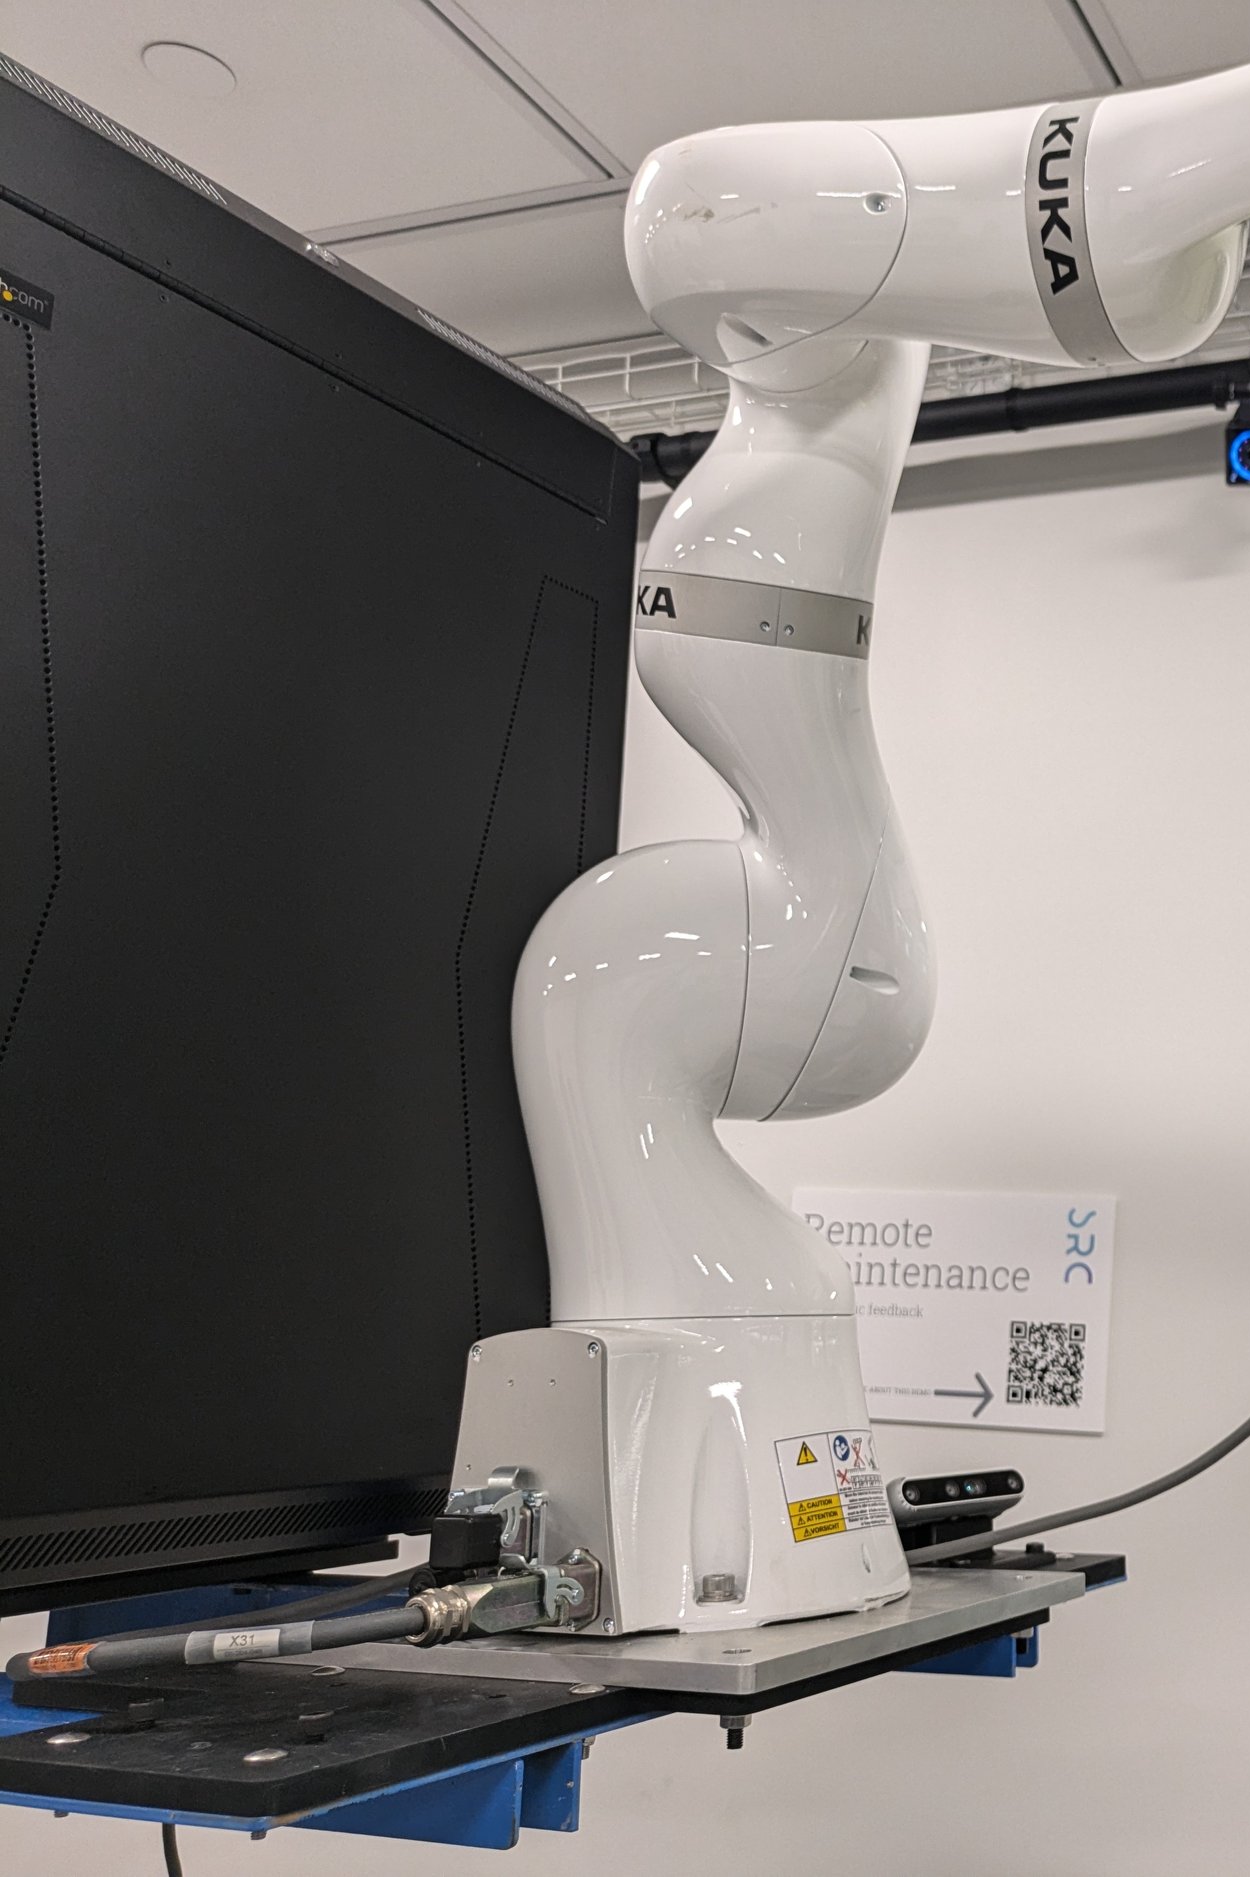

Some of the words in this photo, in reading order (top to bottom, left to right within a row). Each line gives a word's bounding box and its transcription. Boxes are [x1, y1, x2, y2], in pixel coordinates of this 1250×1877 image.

[1038, 116, 1080, 296] KUKA
[636, 585, 677, 619] KA
[1064, 1207, 1097, 1285] SRC
[846, 1252, 1031, 1293] intenance
[868, 1303, 924, 1319] feedback
[806, 1498, 833, 1509] CAUTION
[806, 1510, 839, 1522] ATTENTION
[810, 1522, 840, 1534] VORSICHT
[229, 1634, 255, 1647] X31
